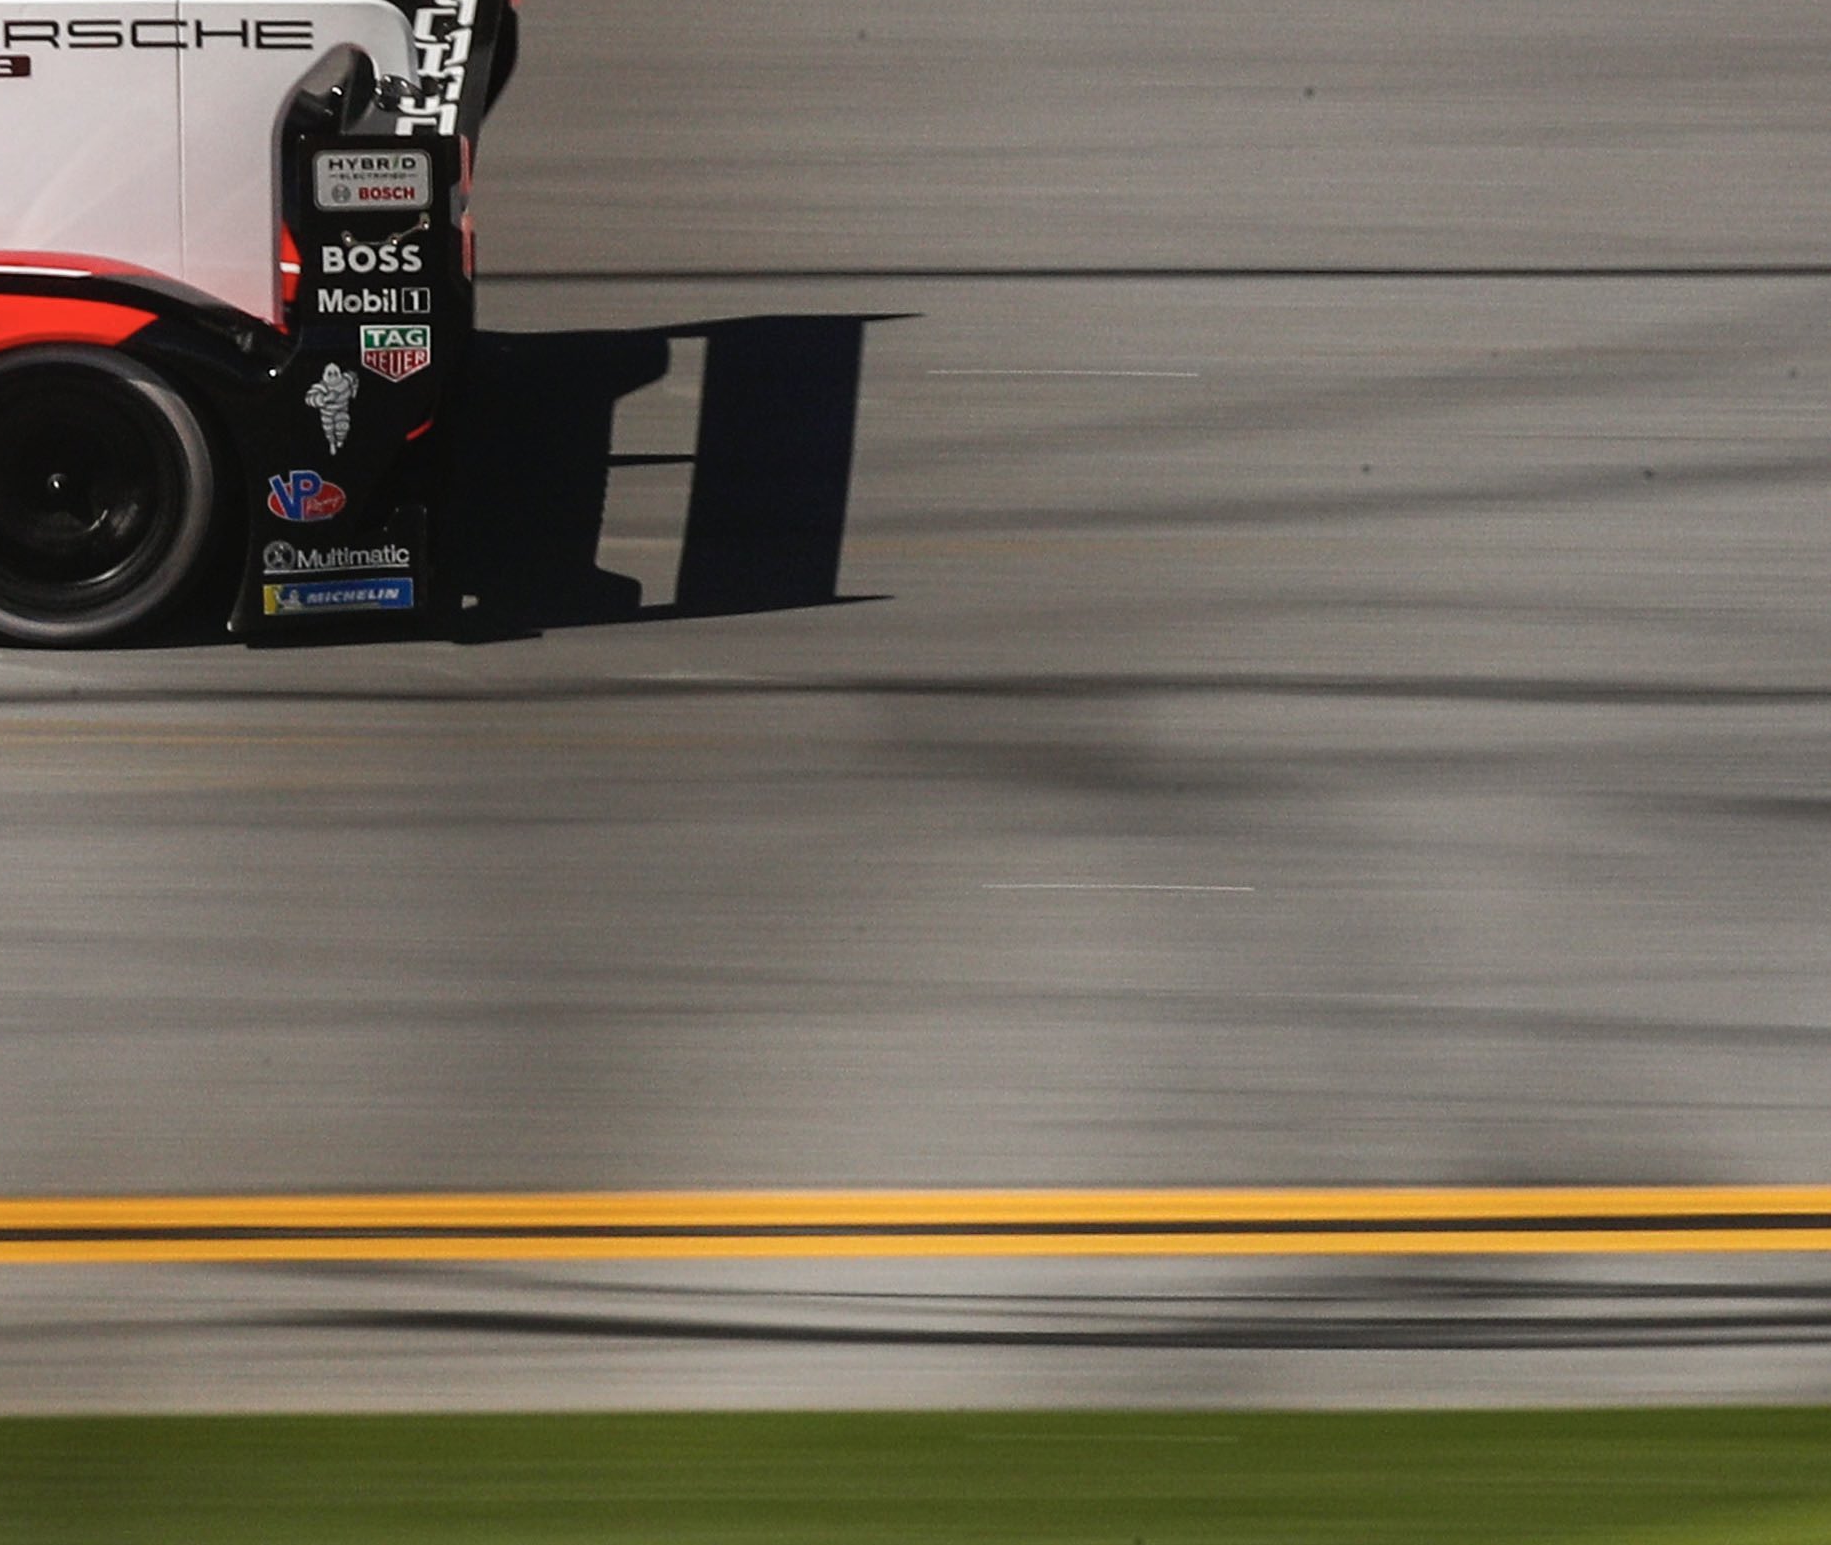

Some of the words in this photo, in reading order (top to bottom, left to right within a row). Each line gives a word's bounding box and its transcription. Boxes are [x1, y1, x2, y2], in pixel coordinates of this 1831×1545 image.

[328, 158, 417, 171] HYBRID
[359, 187, 415, 200] BOSCH
[322, 245, 422, 274] BOSS
[317, 288, 397, 313] Mobil
[367, 330, 423, 346] TAG
[366, 351, 425, 376] HEUER
[269, 470, 323, 520] VP
[297, 543, 410, 569] Multimatic
[306, 587, 401, 605] MICHELIN
